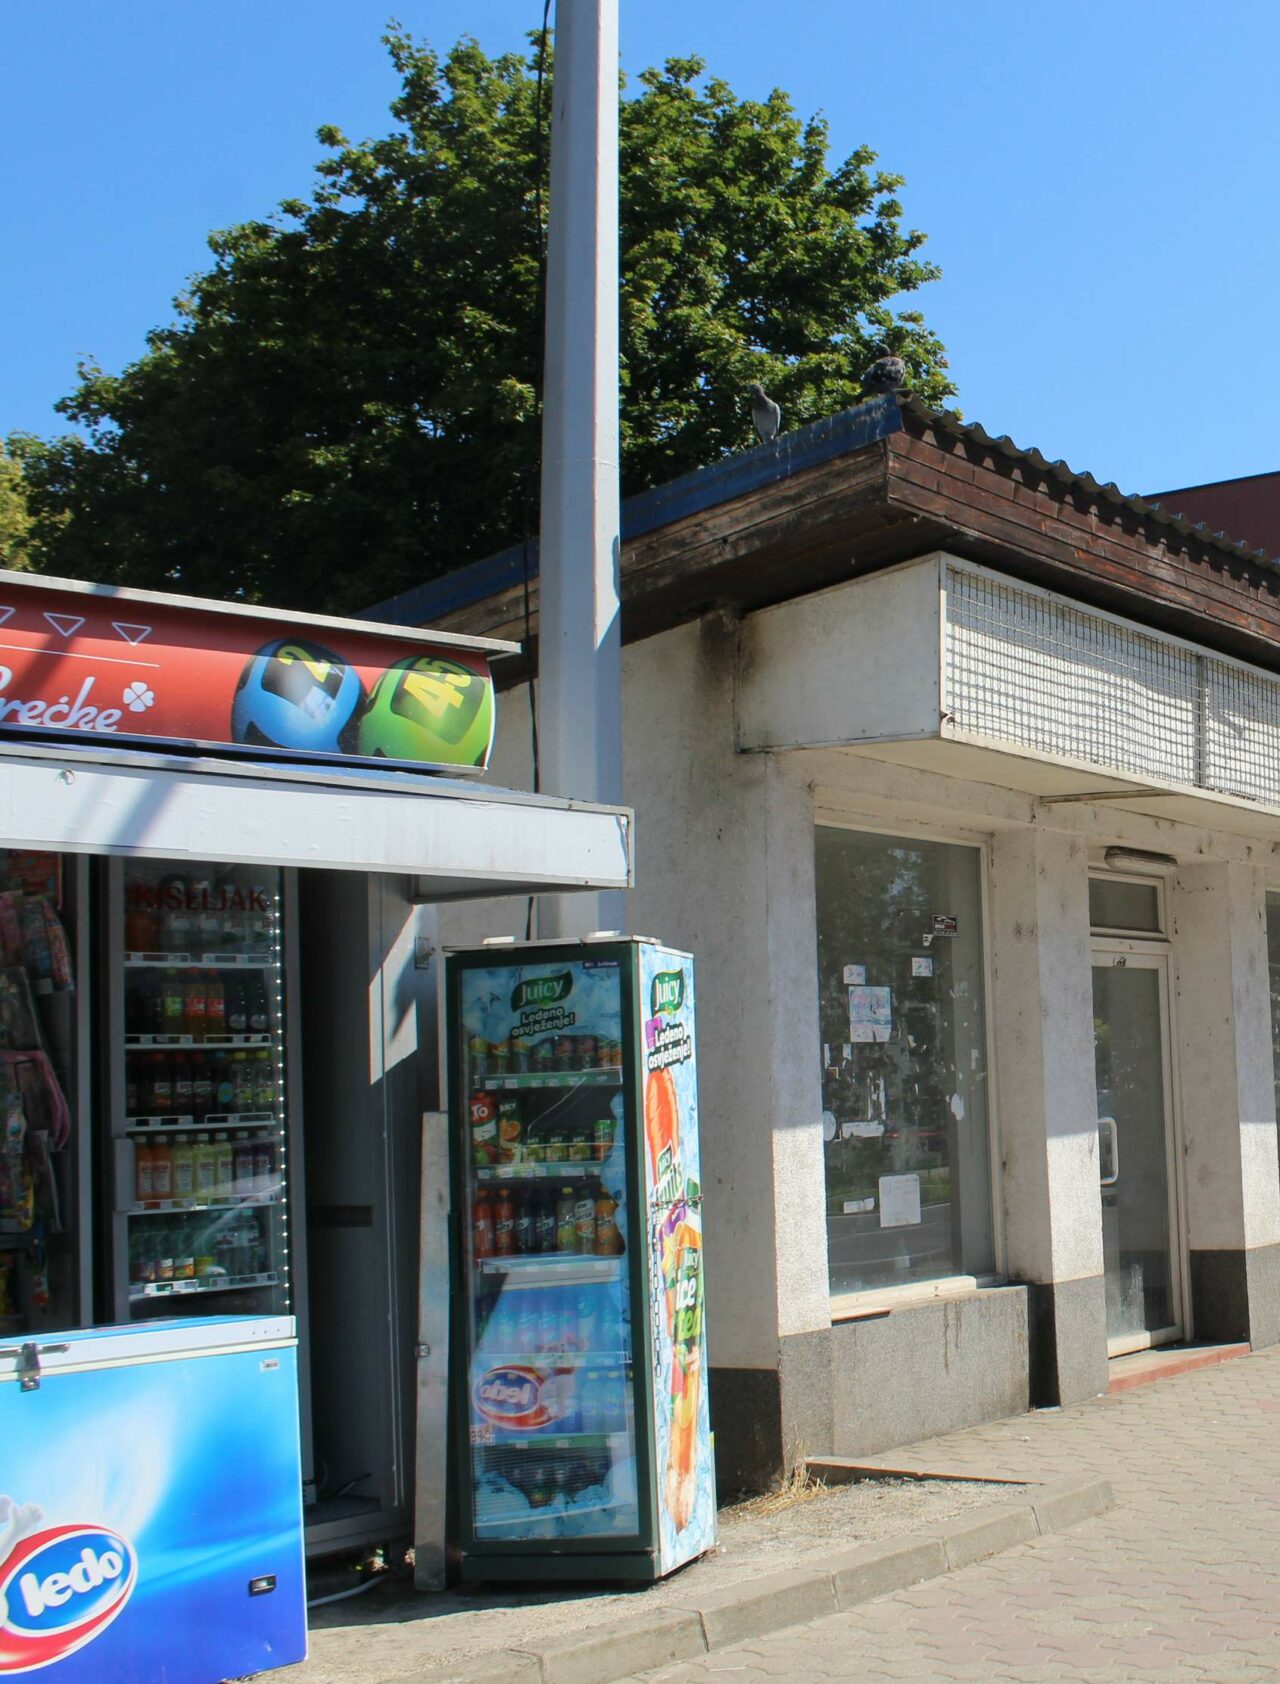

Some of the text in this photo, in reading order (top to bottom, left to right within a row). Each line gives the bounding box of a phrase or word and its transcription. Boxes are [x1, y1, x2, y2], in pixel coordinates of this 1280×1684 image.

[403, 656, 472, 719] 45
[127, 879, 268, 913] KISELJAK
[519, 978, 564, 1006] Juicy
[654, 976, 681, 1011] Juicy
[511, 1014, 575, 1037] osvježenje!
[522, 1007, 564, 1024] Ledeno
[654, 1023, 684, 1045] Ledeno
[20, 1547, 124, 1617] ledo
